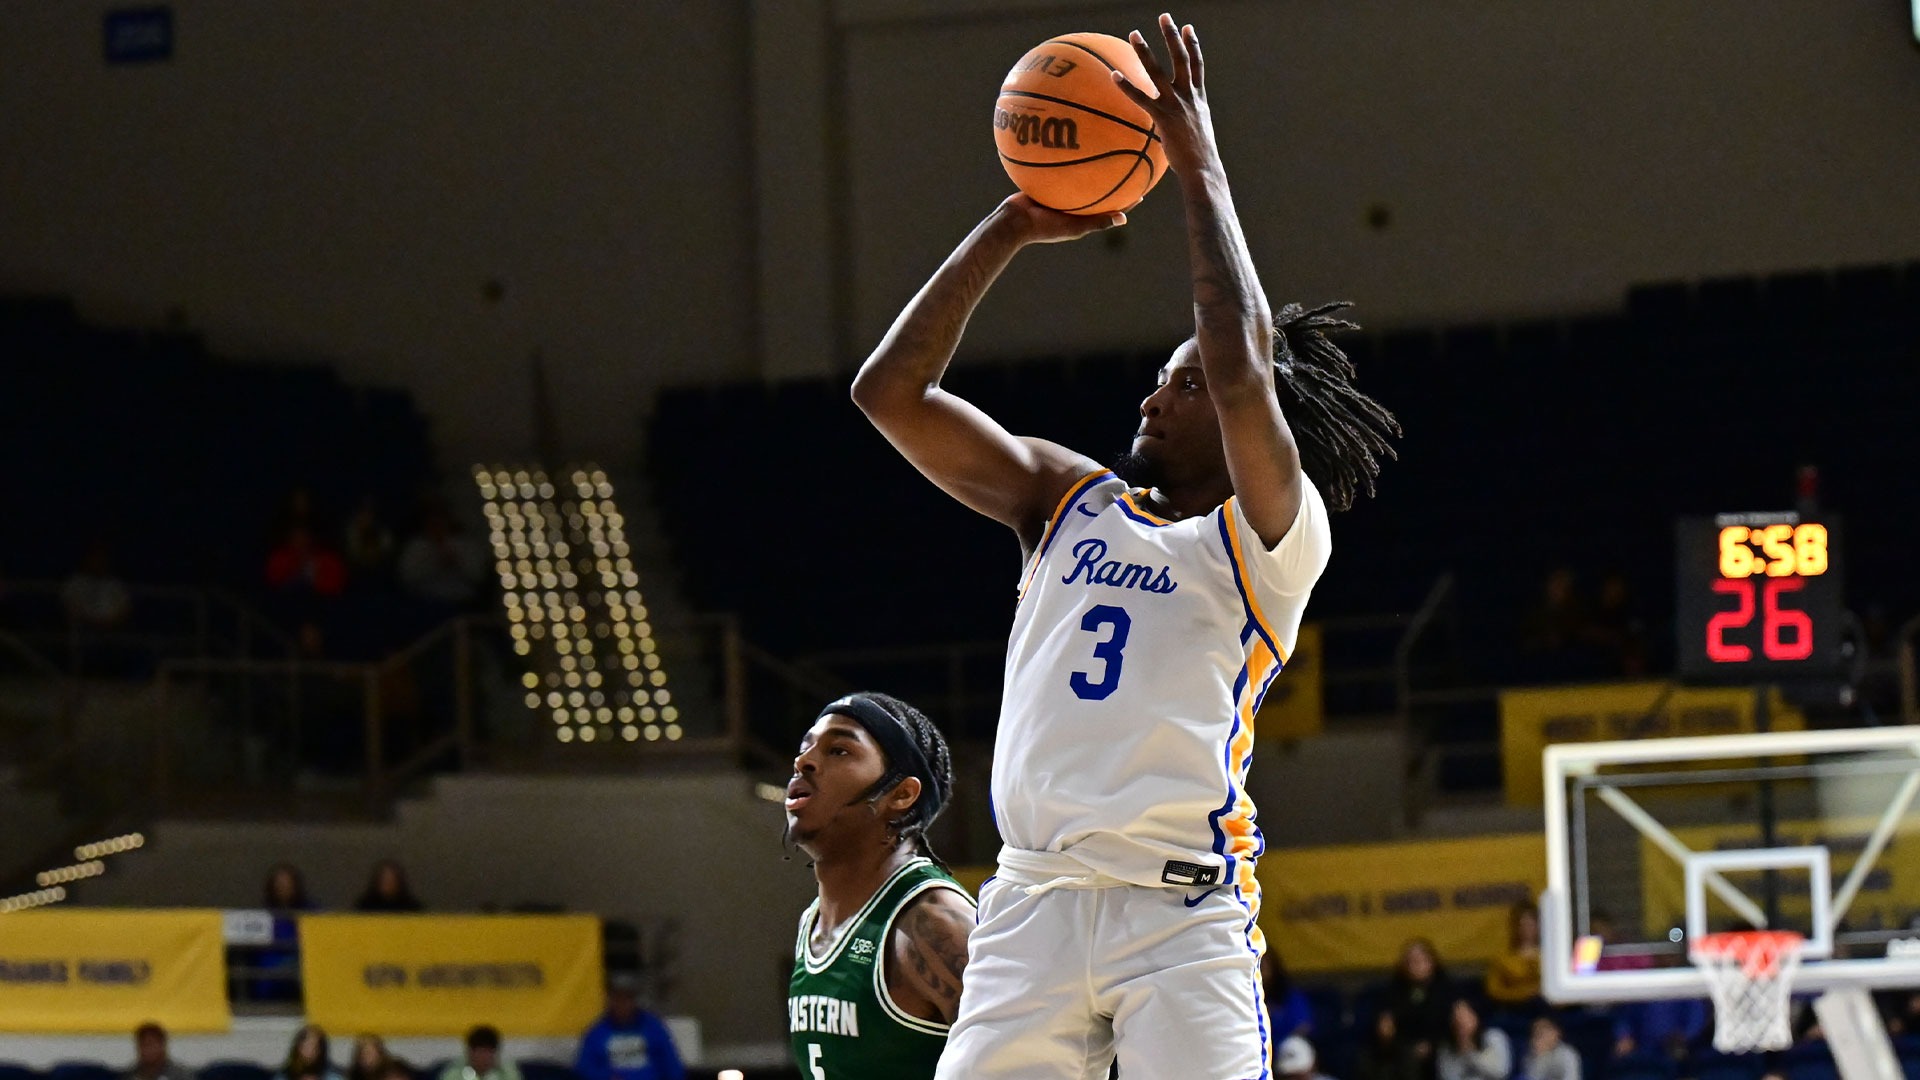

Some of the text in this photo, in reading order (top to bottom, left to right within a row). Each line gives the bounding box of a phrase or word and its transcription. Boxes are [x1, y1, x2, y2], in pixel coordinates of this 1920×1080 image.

[1062, 539, 1178, 594] Rams
[1719, 523, 1828, 578] 6:58
[1070, 604, 1132, 700] 3
[1706, 578, 1813, 662] 26
